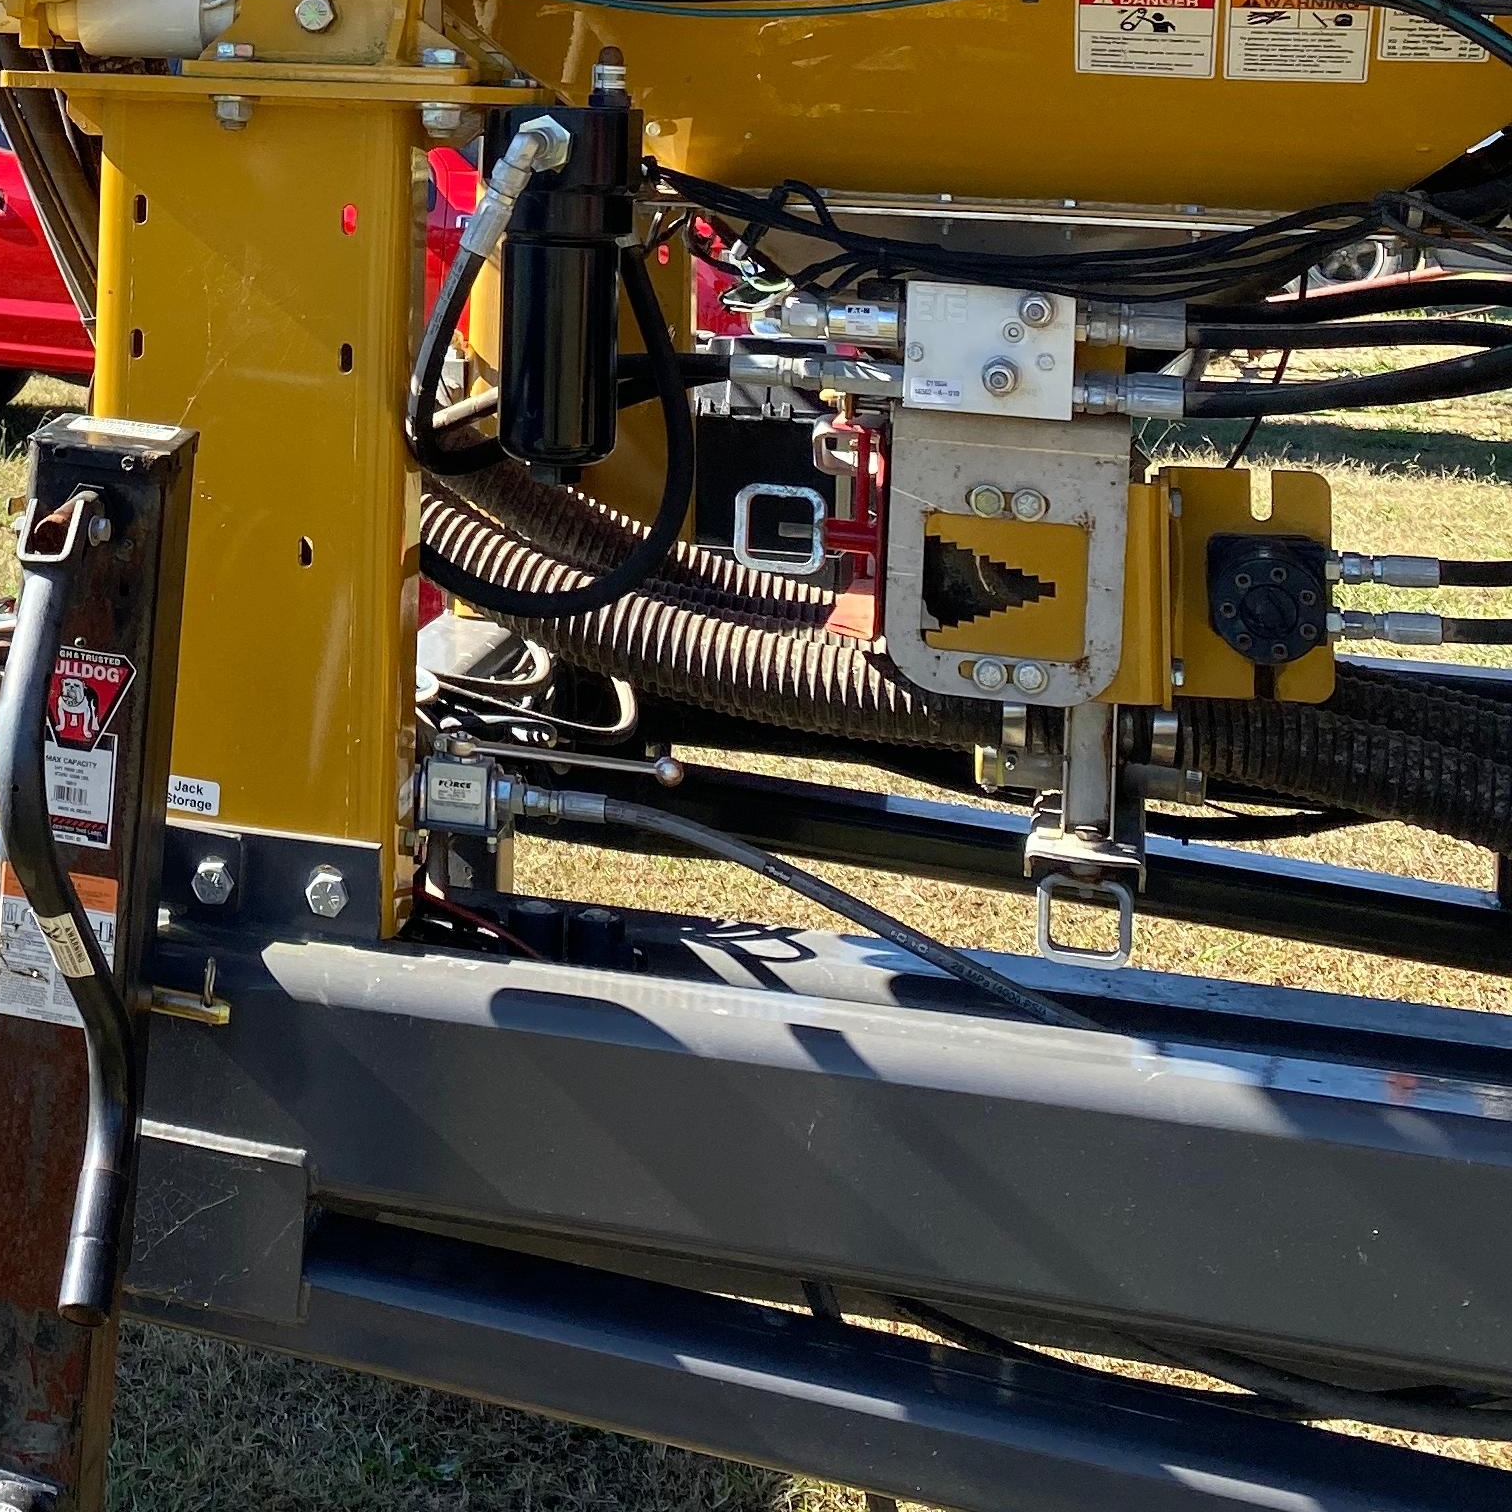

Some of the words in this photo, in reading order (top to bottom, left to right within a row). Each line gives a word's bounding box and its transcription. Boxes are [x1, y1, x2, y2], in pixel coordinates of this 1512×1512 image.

[80, 652, 121, 666] TRUSTED
[55, 659, 120, 683] ULLDOG
[63, 757, 98, 769] CAPACITY
[174, 781, 204, 796] Jack
[167, 792, 212, 812] Storage
[67, 931, 86, 964] WARNING
